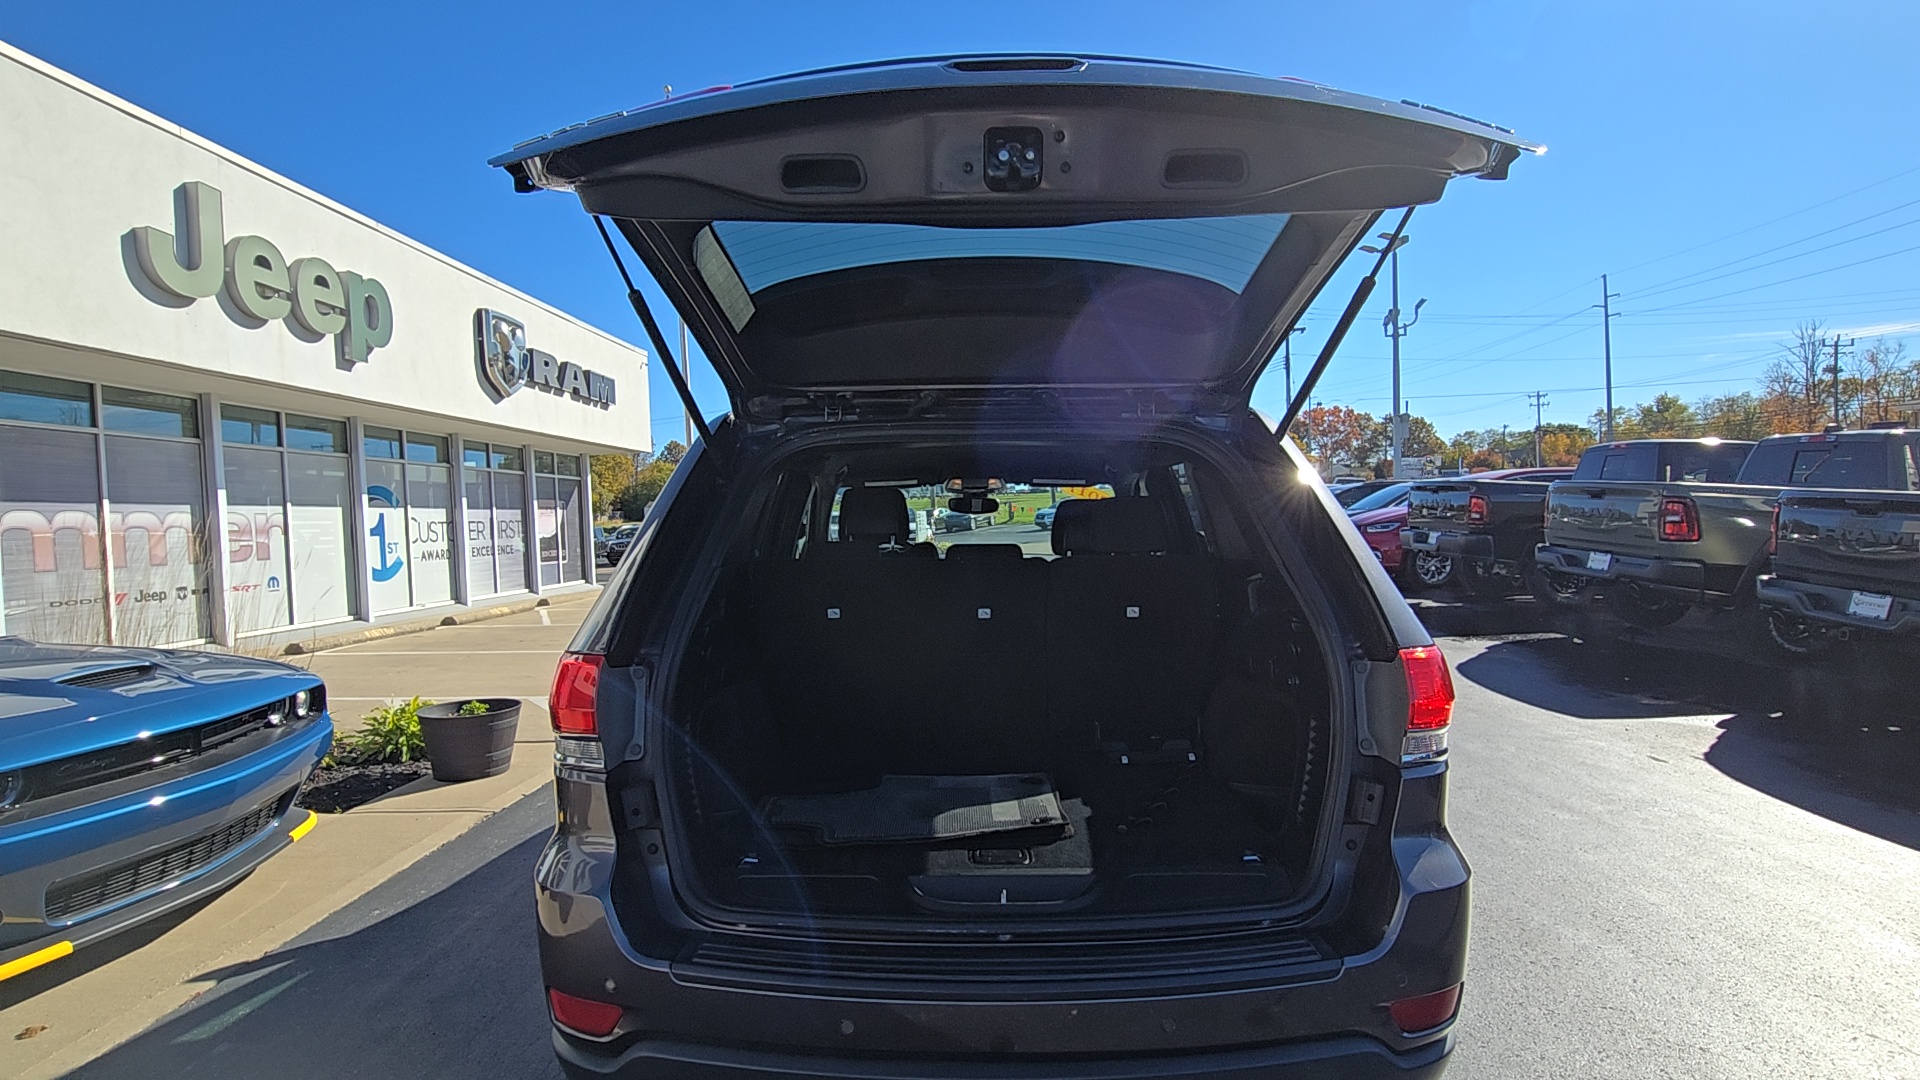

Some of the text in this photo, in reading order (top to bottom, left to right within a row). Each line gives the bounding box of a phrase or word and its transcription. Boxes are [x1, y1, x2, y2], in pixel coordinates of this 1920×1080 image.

[120, 181, 393, 371] Jeep
[525, 348, 616, 410] RAM
[410, 516, 522, 545] CUSTOER IRST
[1826, 527, 1914, 547] RAM
[421, 545, 514, 562] AWARD EXCEENCE
[134, 590, 168, 604] Jeep
[231, 584, 261, 593] SRT
